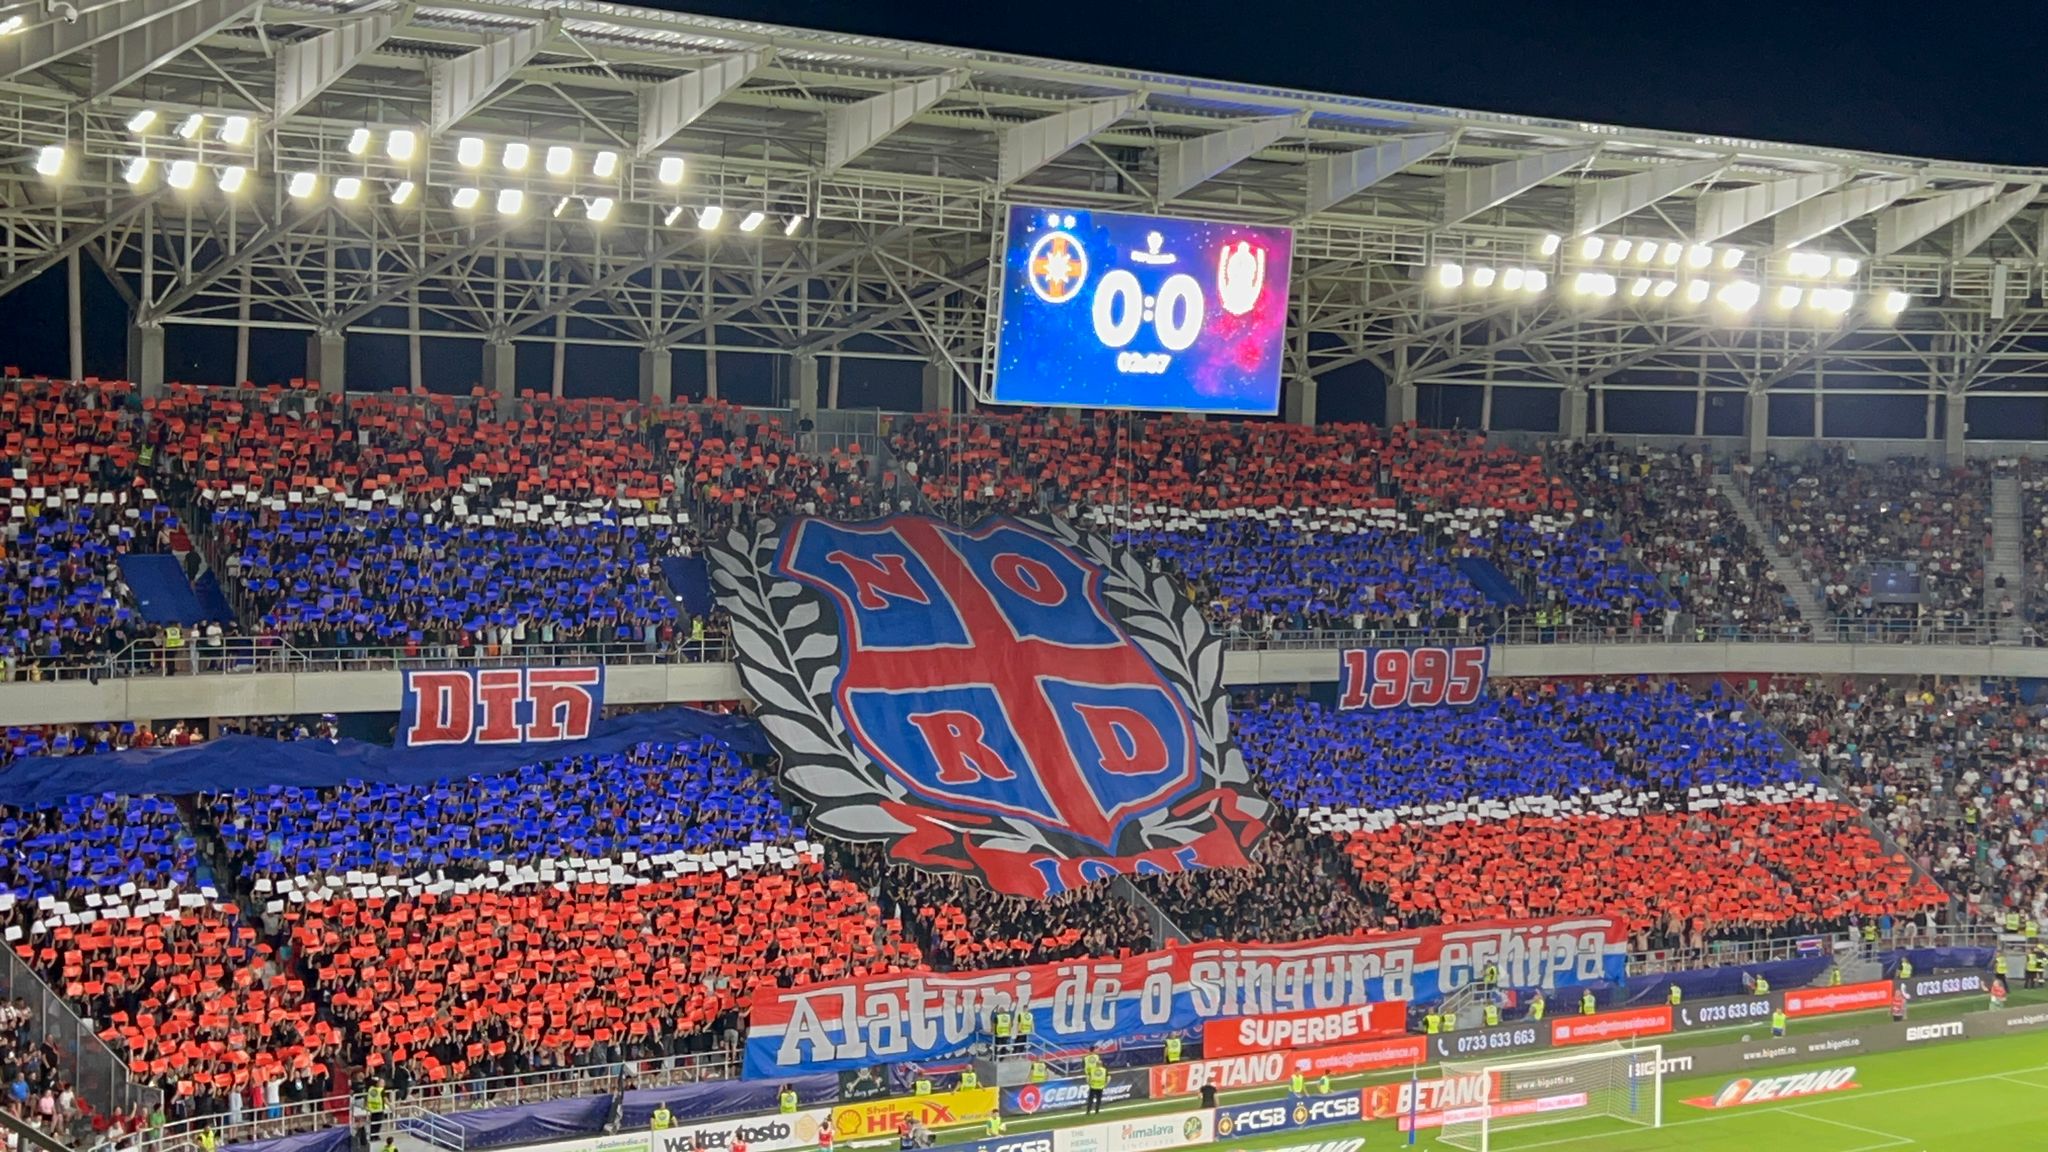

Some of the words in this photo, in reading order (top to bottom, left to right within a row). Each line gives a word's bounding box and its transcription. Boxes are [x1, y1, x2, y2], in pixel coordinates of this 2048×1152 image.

[1339, 647, 1485, 711] 1995
[907, 711, 1015, 785] R
[1073, 703, 1169, 776] D
[1700, 1004, 1726, 1021] 0733
[1728, 1003, 1749, 1018] 633
[1750, 1000, 1771, 1016] 663
[1238, 1005, 1374, 1046] SUPERBET
[1906, 1021, 1964, 1041] BIGOTTI
[1458, 1033, 1487, 1052] 0733
[1490, 1031, 1512, 1049] 633
[1514, 1028, 1536, 1045] 663
[1808, 1037, 1861, 1052] www.bigotti.ro
[1743, 1045, 1797, 1060] www.bigotti.ro
[1185, 1053, 1285, 1093] BETANO
[1741, 1066, 1857, 1104] BETANO
[1396, 1075, 1492, 1113] BETANO
[866, 1104, 896, 1116] Shell
[1234, 1107, 1287, 1132] FCSB
[1309, 1097, 1360, 1121] FCSB
